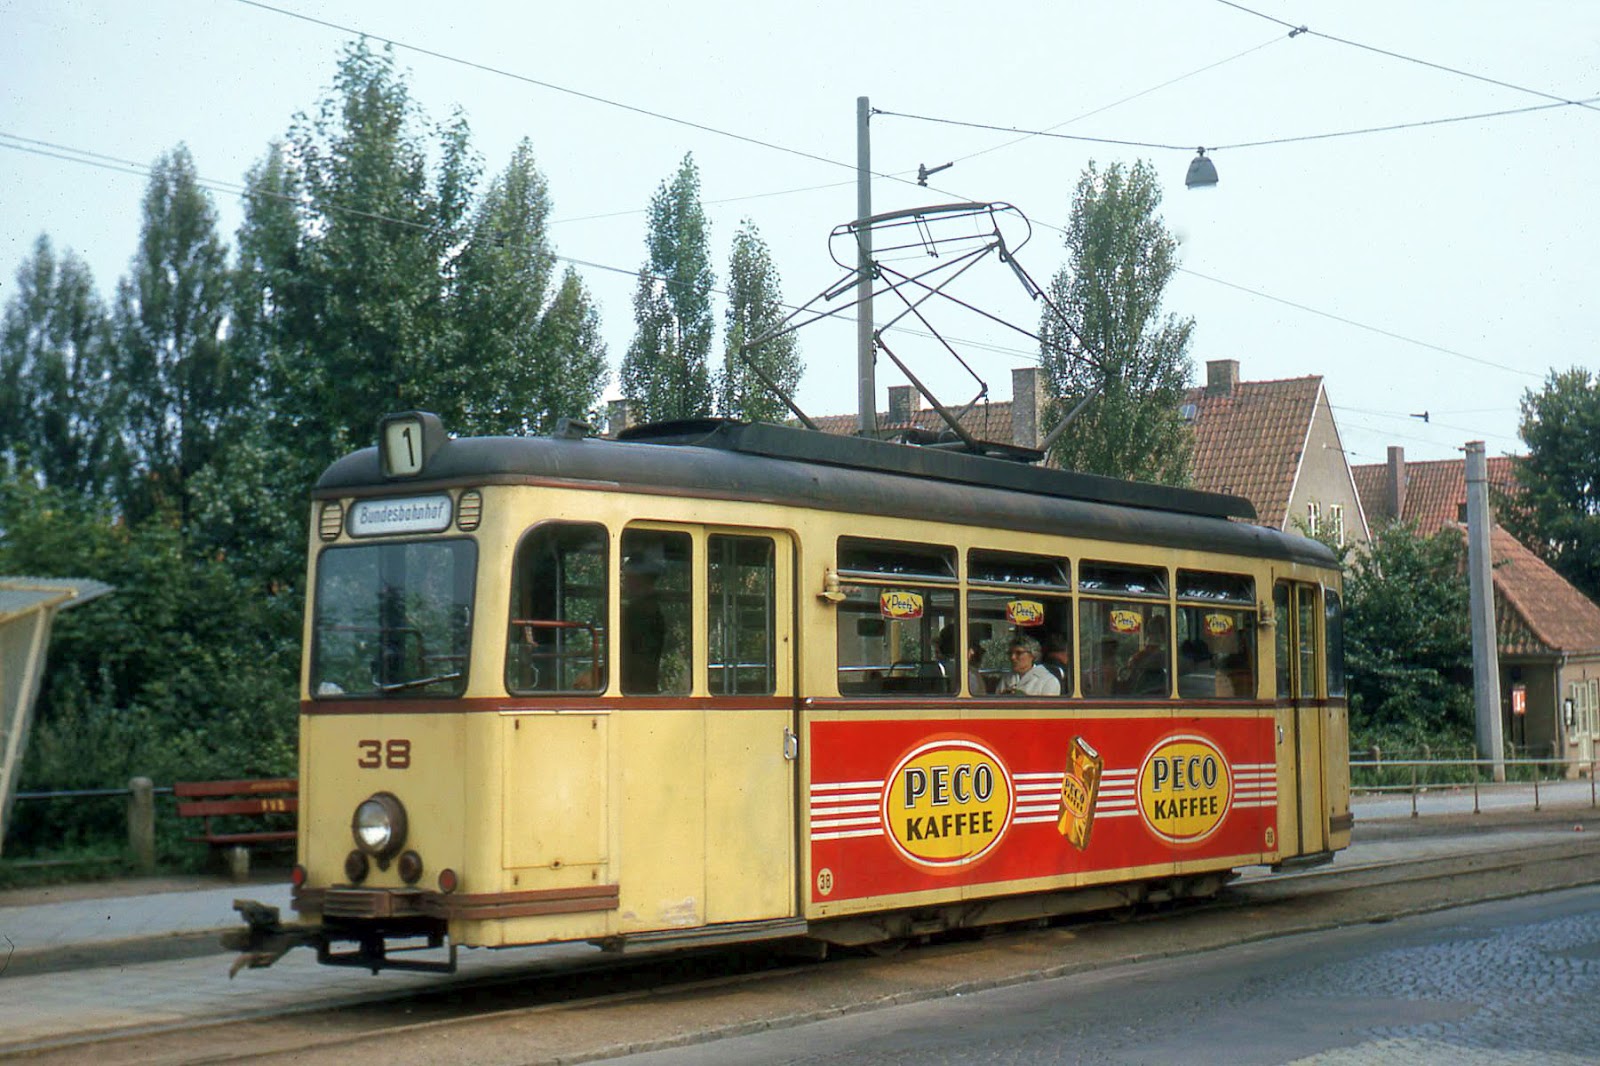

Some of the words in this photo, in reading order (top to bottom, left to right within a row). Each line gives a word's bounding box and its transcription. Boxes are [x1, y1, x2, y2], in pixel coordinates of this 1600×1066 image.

[402, 427, 415, 467] 1
[360, 501, 445, 524] Bundesbahnhof
[358, 739, 411, 769] 38
[903, 762, 994, 810] PECO
[1152, 754, 1217, 793] PECO
[1065, 777, 1085, 805] PECO
[1154, 795, 1218, 820] KAFFEE
[906, 811, 993, 842] KAFFEE
[819, 873, 832, 890] 38
